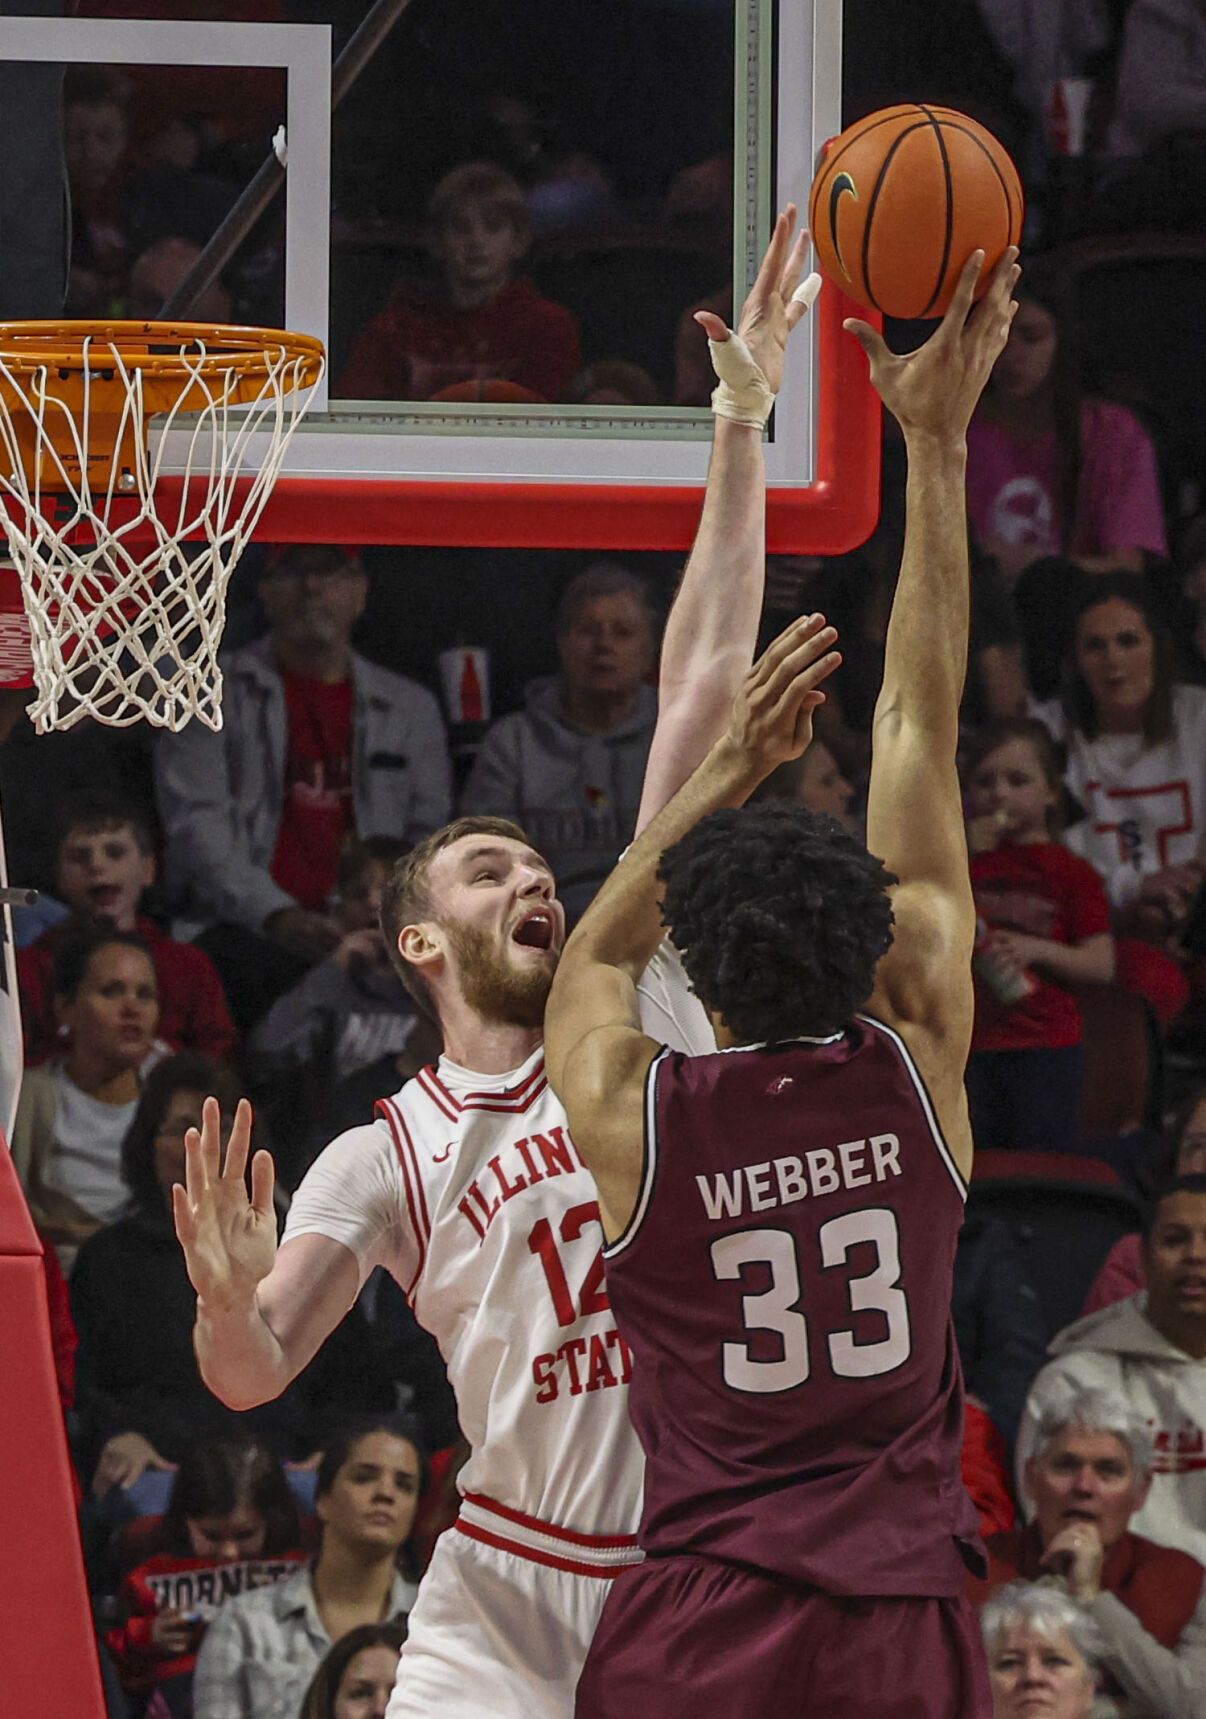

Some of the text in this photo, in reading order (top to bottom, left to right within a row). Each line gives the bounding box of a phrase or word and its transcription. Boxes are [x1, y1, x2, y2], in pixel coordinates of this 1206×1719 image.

[457, 1126, 590, 1247] ILLIN
[695, 1133, 902, 1220] WEBBER
[527, 1200, 611, 1328] 12
[709, 1207, 912, 1393] 33
